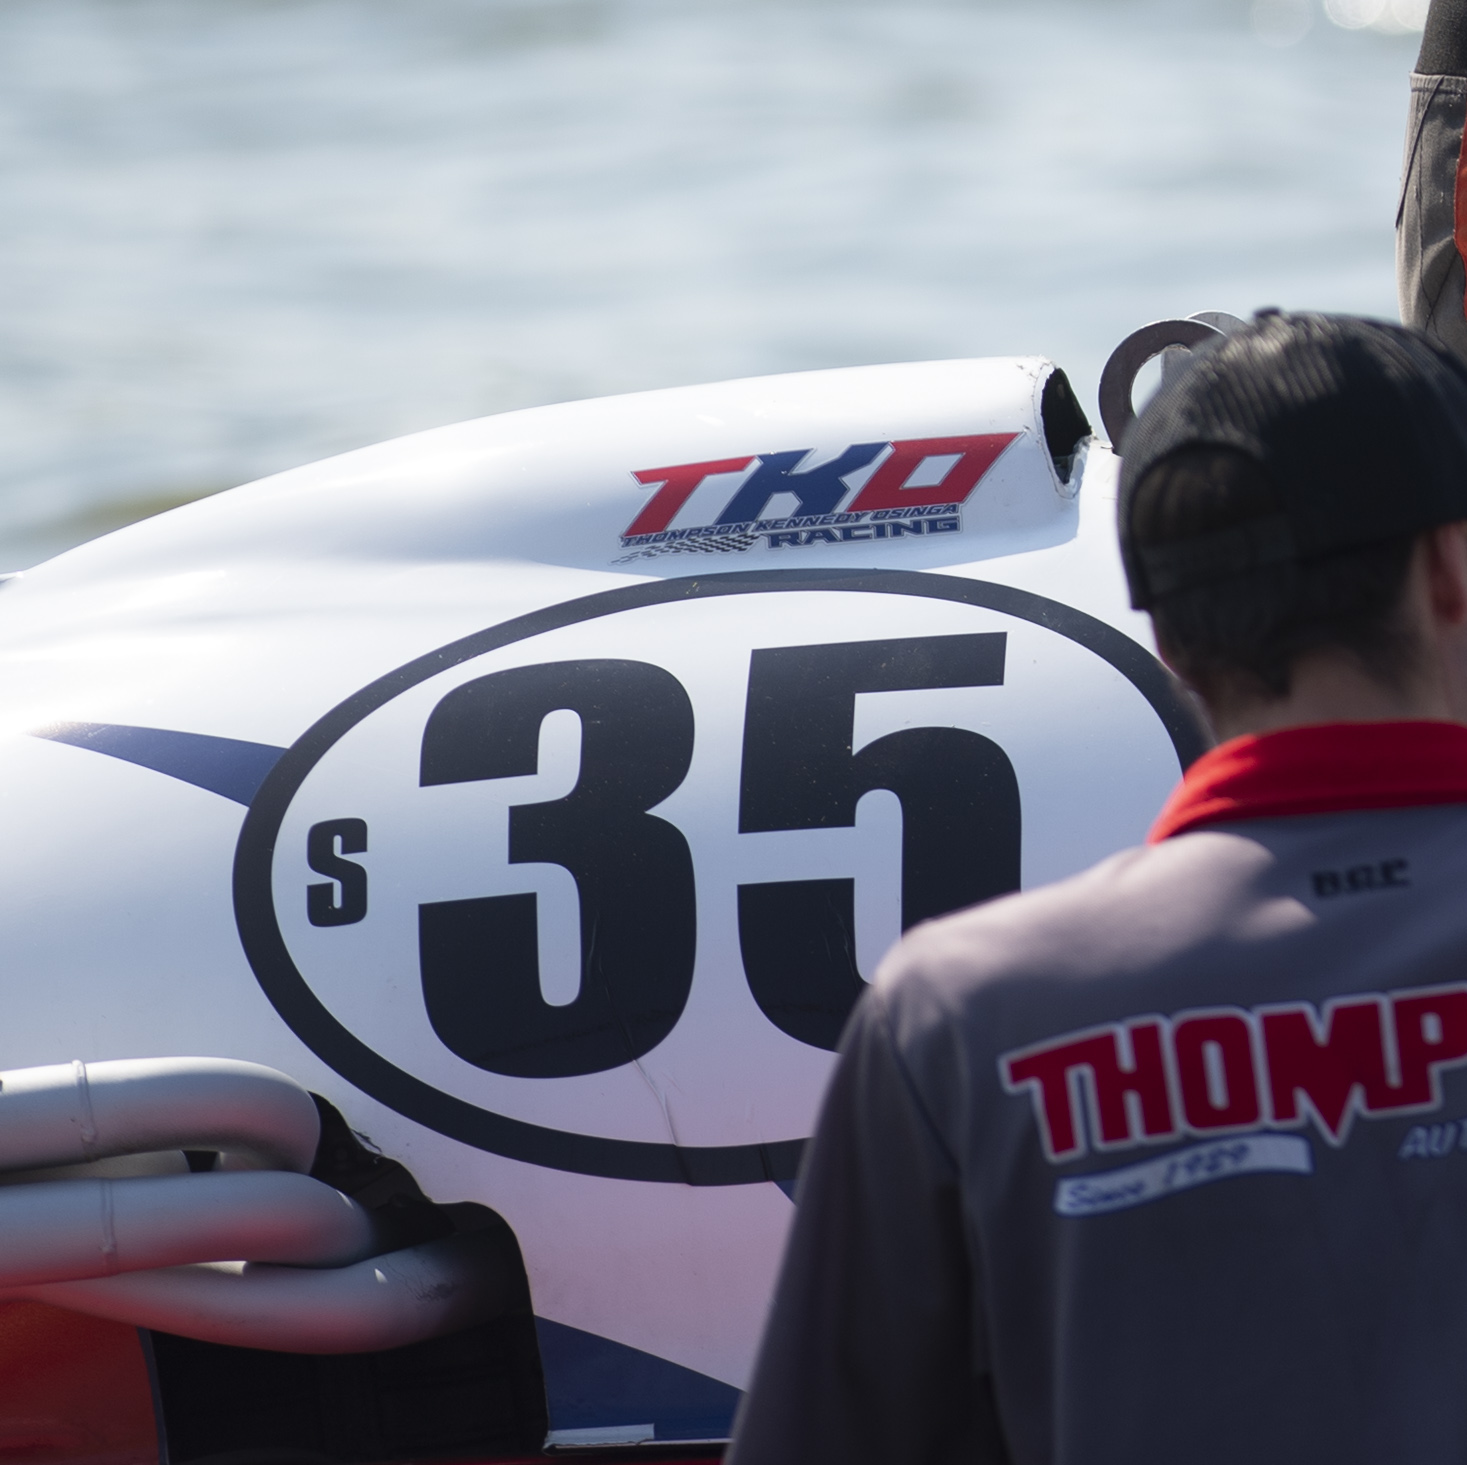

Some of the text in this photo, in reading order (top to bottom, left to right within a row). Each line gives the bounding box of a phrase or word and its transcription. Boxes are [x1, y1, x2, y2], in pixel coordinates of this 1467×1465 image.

[624, 432, 1022, 538] TKO
[621, 503, 959, 548] THOMPSON KENNEDY OSINGA
[766, 515, 962, 549] RACING
[306, 630, 1022, 1080] S 35
